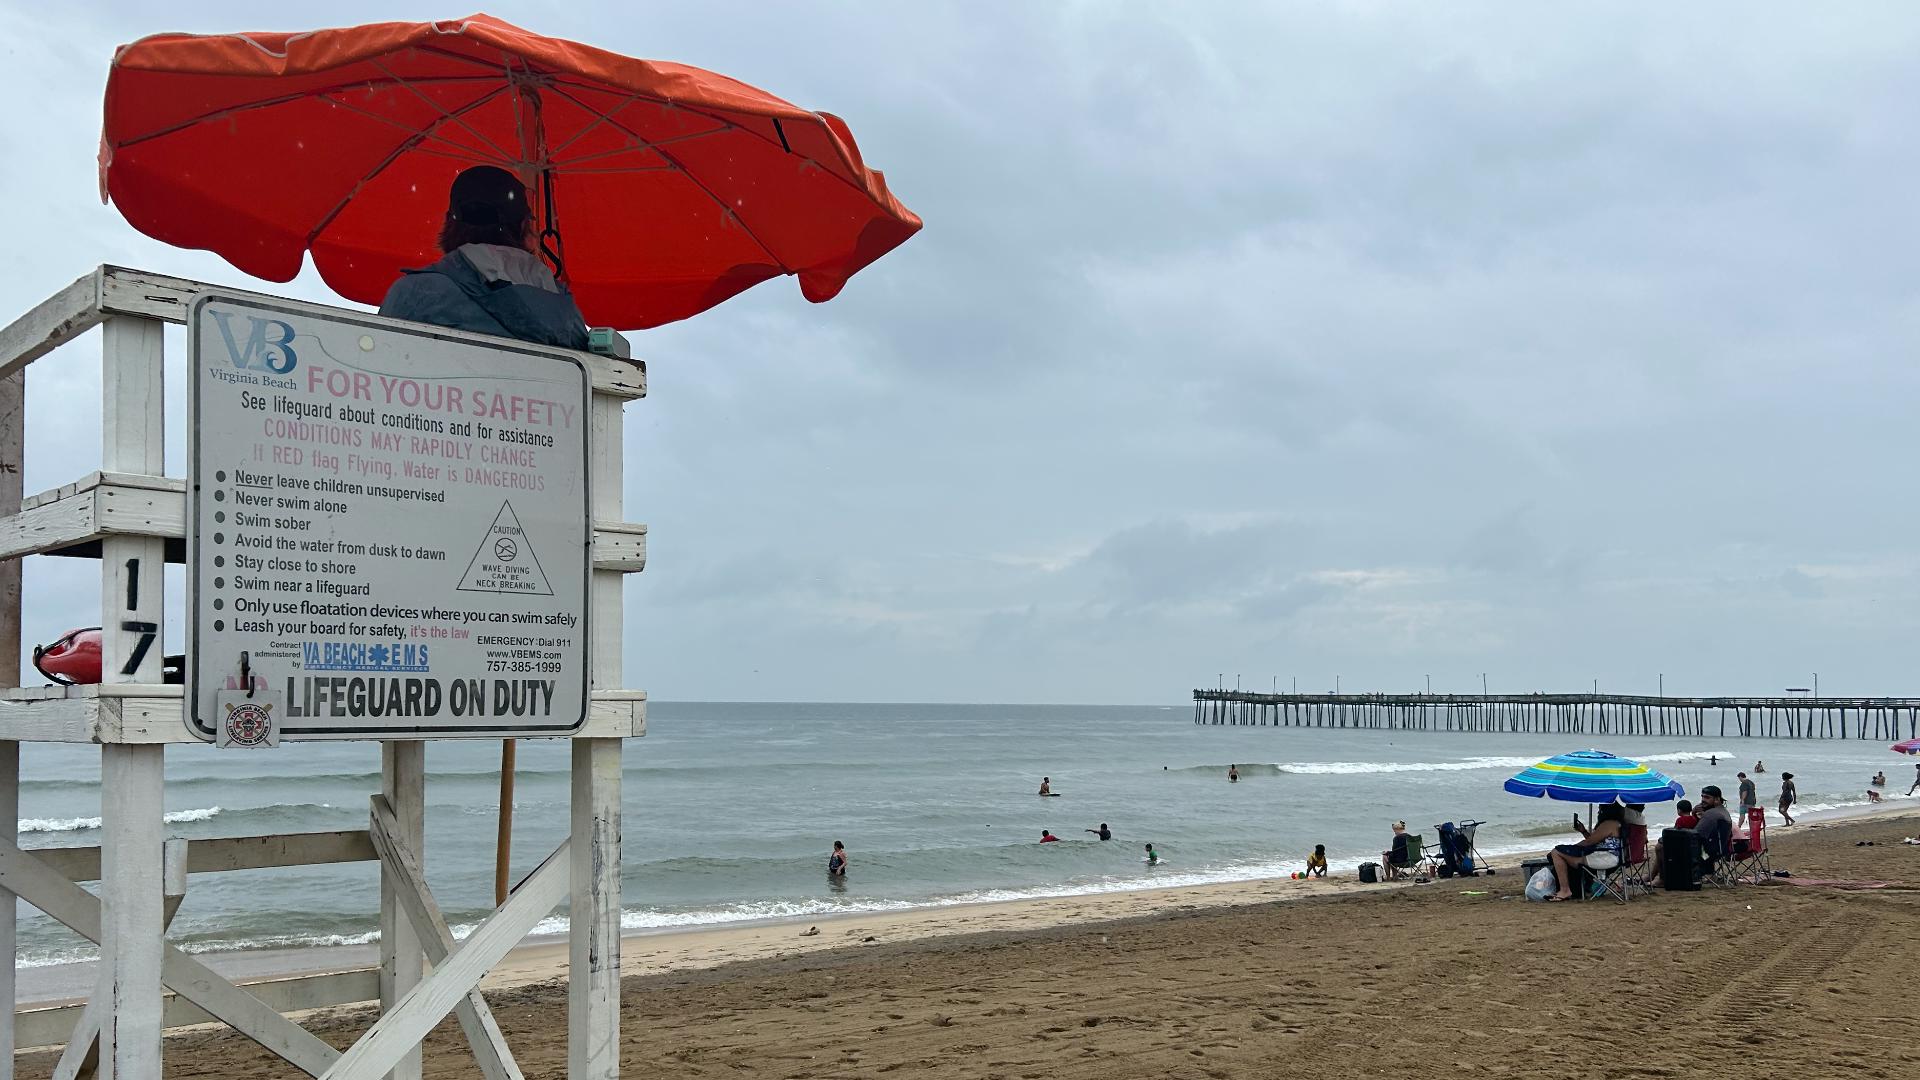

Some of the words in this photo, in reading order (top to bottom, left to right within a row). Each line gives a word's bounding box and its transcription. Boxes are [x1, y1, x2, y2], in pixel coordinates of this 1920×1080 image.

[208, 309, 298, 375] VB
[210, 367, 258, 385] Virginia
[262, 375, 297, 390] Beach
[307, 365, 372, 401] FOR
[379, 375, 464, 414] YOUR
[472, 390, 575, 429] SAFETY
[241, 390, 266, 411] See
[273, 395, 332, 420] lifeguard
[339, 404, 375, 425] about
[381, 411, 444, 434] conditions
[449, 421, 471, 437] and
[477, 422, 493, 440] for
[498, 427, 554, 448] assistance
[264, 417, 363, 448] CONDITIONS
[371, 431, 401, 453] MAY
[411, 436, 473, 461] RAPIDLY
[481, 445, 537, 469] CHANGE
[272, 444, 304, 466] RED
[312, 449, 339, 475] flag
[403, 459, 440, 480] Water
[448, 465, 458, 482] is
[465, 467, 545, 491] DANGEROUS
[235, 469, 273, 487] Never
[277, 474, 310, 490] leave
[313, 478, 363, 495] children
[366, 485, 445, 503] unsupervised
[235, 490, 273, 507] Never
[277, 496, 310, 511] swim
[313, 498, 347, 514] alone
[235, 511, 271, 528] Swim
[274, 515, 311, 531] sober
[493, 525, 521, 536] CAUTION
[235, 533, 273, 549] Avoid
[276, 536, 296, 550] the
[300, 539, 334, 553] water
[337, 540, 365, 555] from
[369, 543, 398, 558] dusk
[400, 545, 413, 559] to
[415, 546, 446, 561] dawn
[235, 554, 264, 573] Stay
[267, 556, 302, 572] close
[305, 559, 318, 573] to
[321, 559, 356, 575] shore
[482, 564, 502, 573] WAVE
[505, 565, 530, 575] DIVING
[234, 575, 270, 591] Swim
[274, 578, 302, 593] near
[305, 581, 313, 593] a
[316, 579, 370, 598] lifeguard
[476, 579, 496, 588] NECK
[500, 580, 536, 590] BREAKING
[234, 597, 270, 616] Only
[273, 602, 298, 614] use
[300, 600, 367, 617] floatation
[370, 603, 419, 619] devices
[421, 606, 461, 621] where
[462, 611, 486, 624] you
[488, 613, 509, 623] can
[511, 611, 542, 624] swim
[544, 612, 577, 629] safely
[234, 617, 274, 633] Leash
[277, 622, 307, 637] your
[310, 620, 346, 635] board
[349, 622, 366, 636] for
[369, 623, 407, 640] safety,
[410, 624, 427, 638] it's
[430, 625, 448, 638] the
[451, 627, 470, 639] law
[254, 649, 301, 659] administered
[270, 640, 301, 649] Contract
[303, 642, 320, 665] VA
[324, 642, 366, 666] BEACH
[556, 638, 571, 647] 911
[292, 660, 301, 669] by
[486, 649, 562, 660] www.VBEMS.com
[486, 660, 562, 673] 757-385-1999
[286, 676, 442, 718] LIFEGUARD
[449, 678, 486, 717] ON
[493, 679, 556, 717] DUTY
